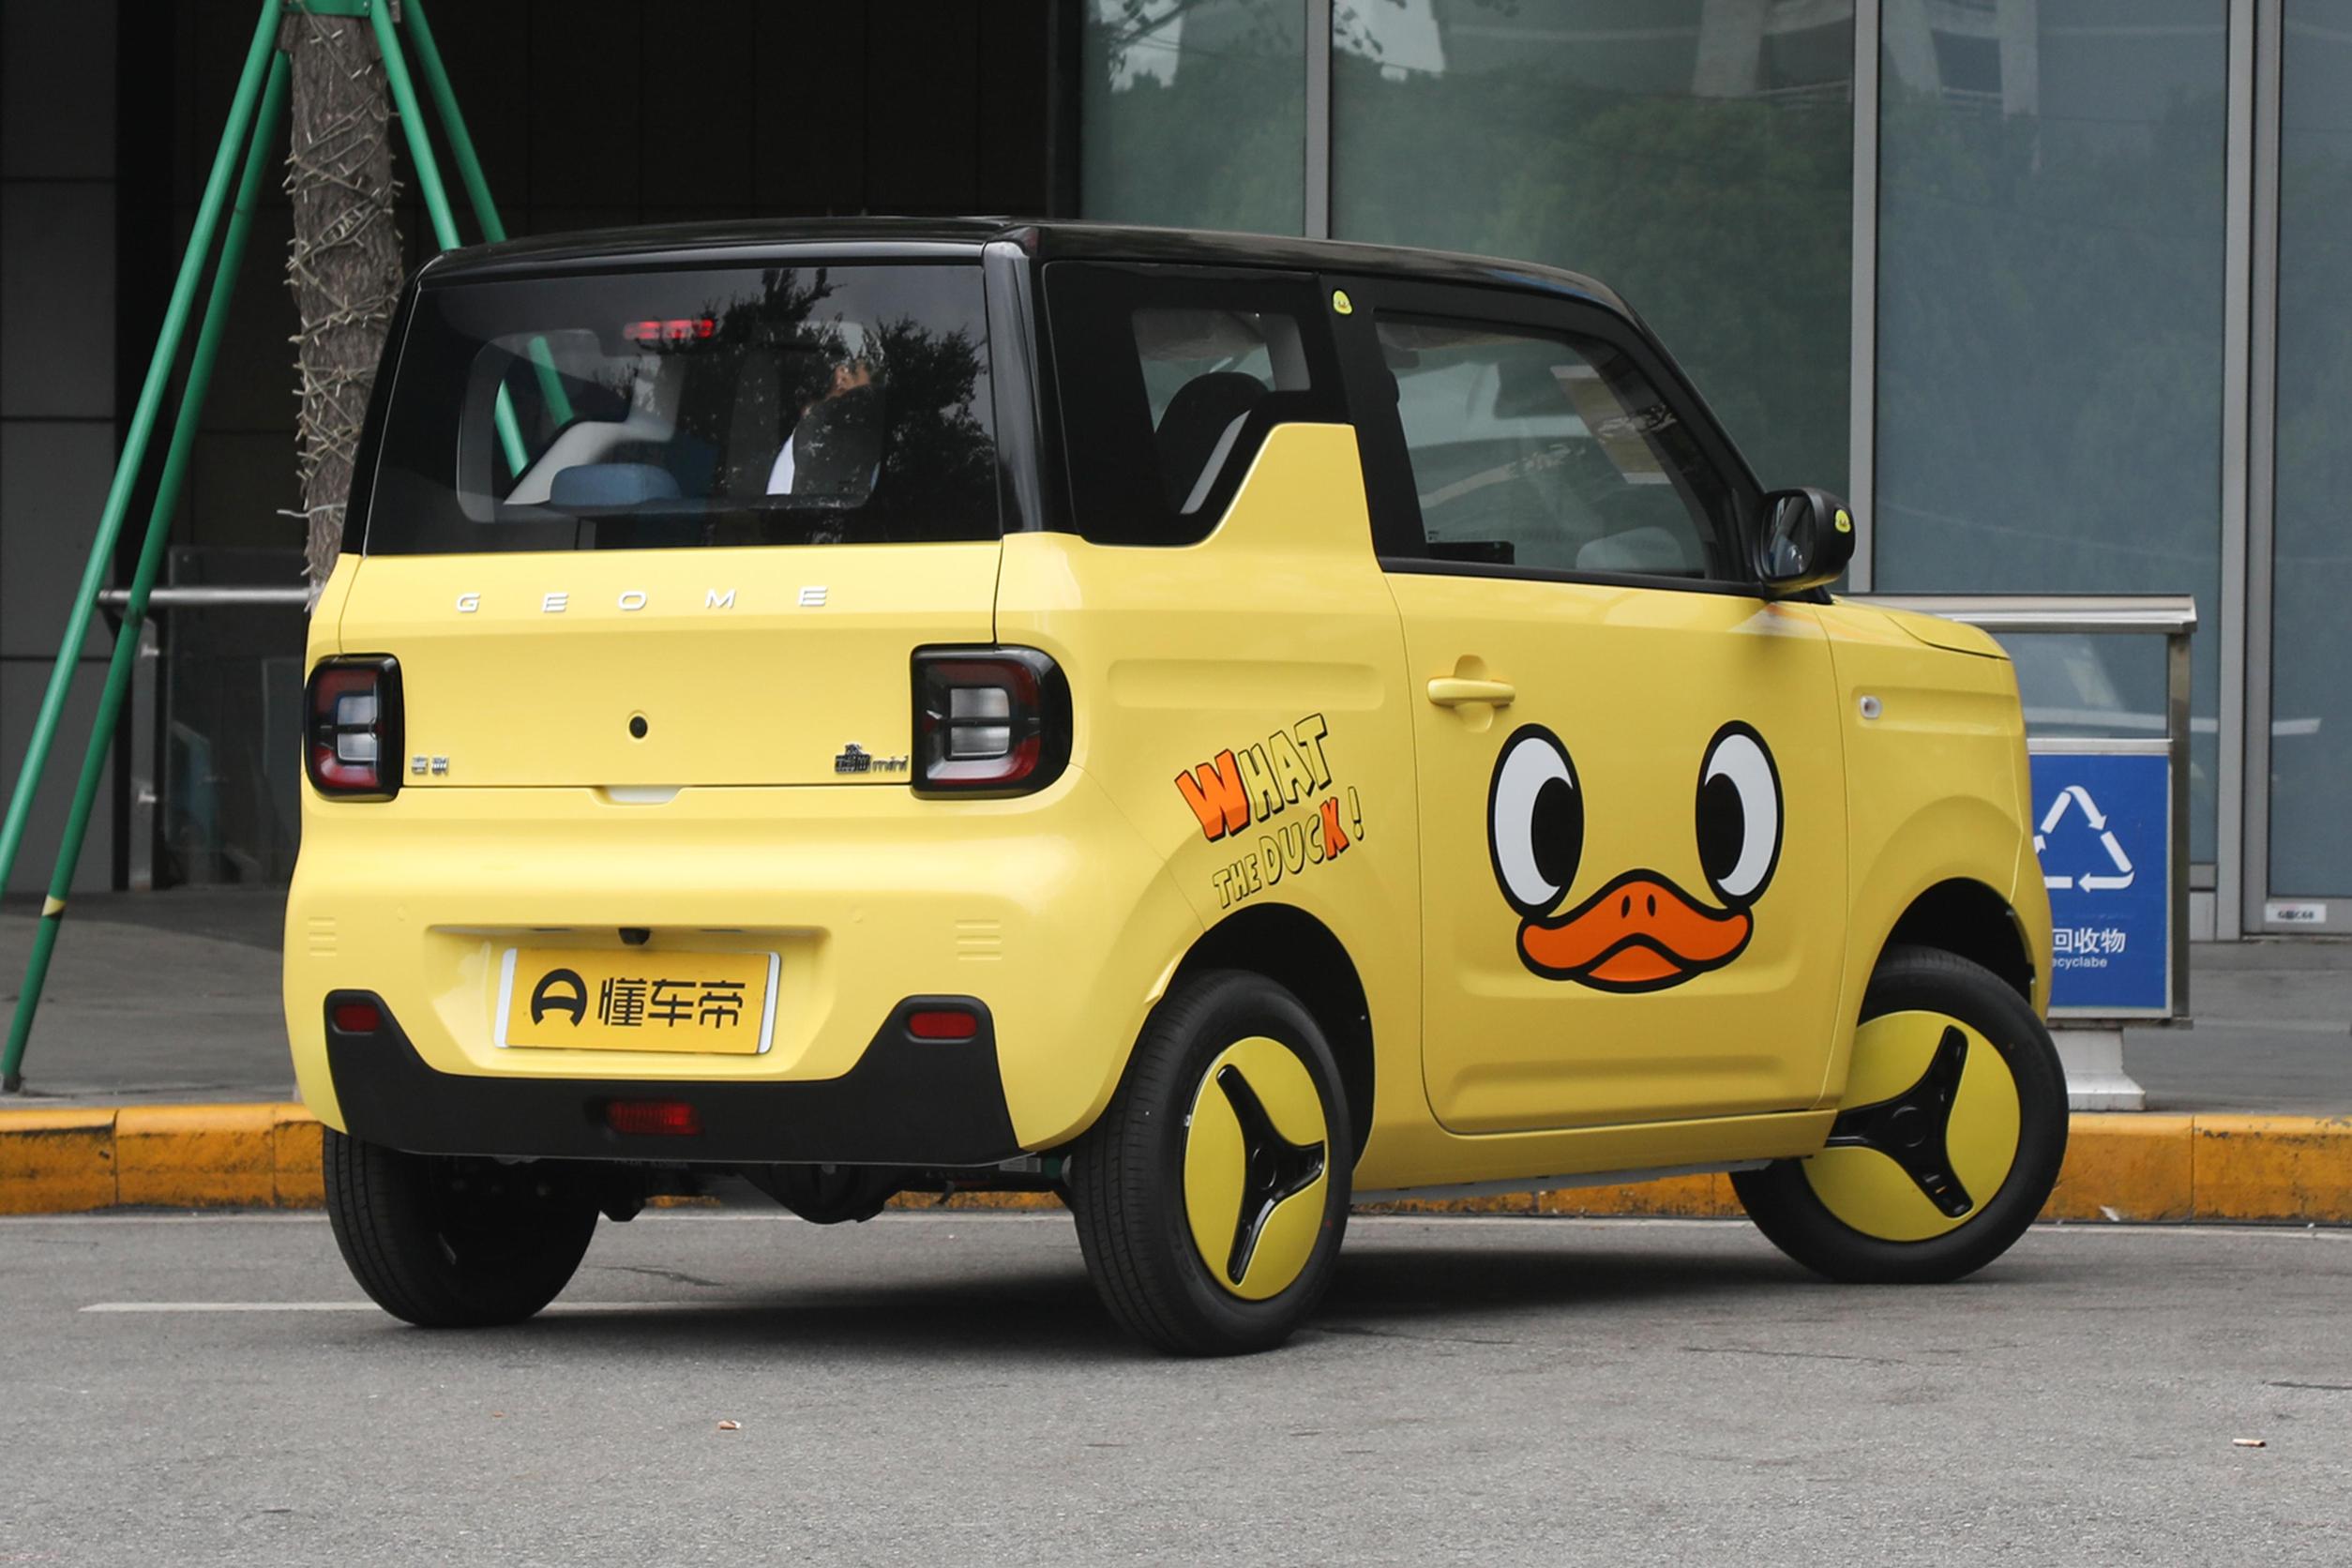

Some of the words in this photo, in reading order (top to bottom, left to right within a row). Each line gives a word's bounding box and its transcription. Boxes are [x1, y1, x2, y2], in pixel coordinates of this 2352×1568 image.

[456, 586, 828, 613] GEOME
[1173, 712, 1333, 843] WHAT
[1212, 852, 1263, 910] THE
[596, 976, 746, 1030] 懂车帝
